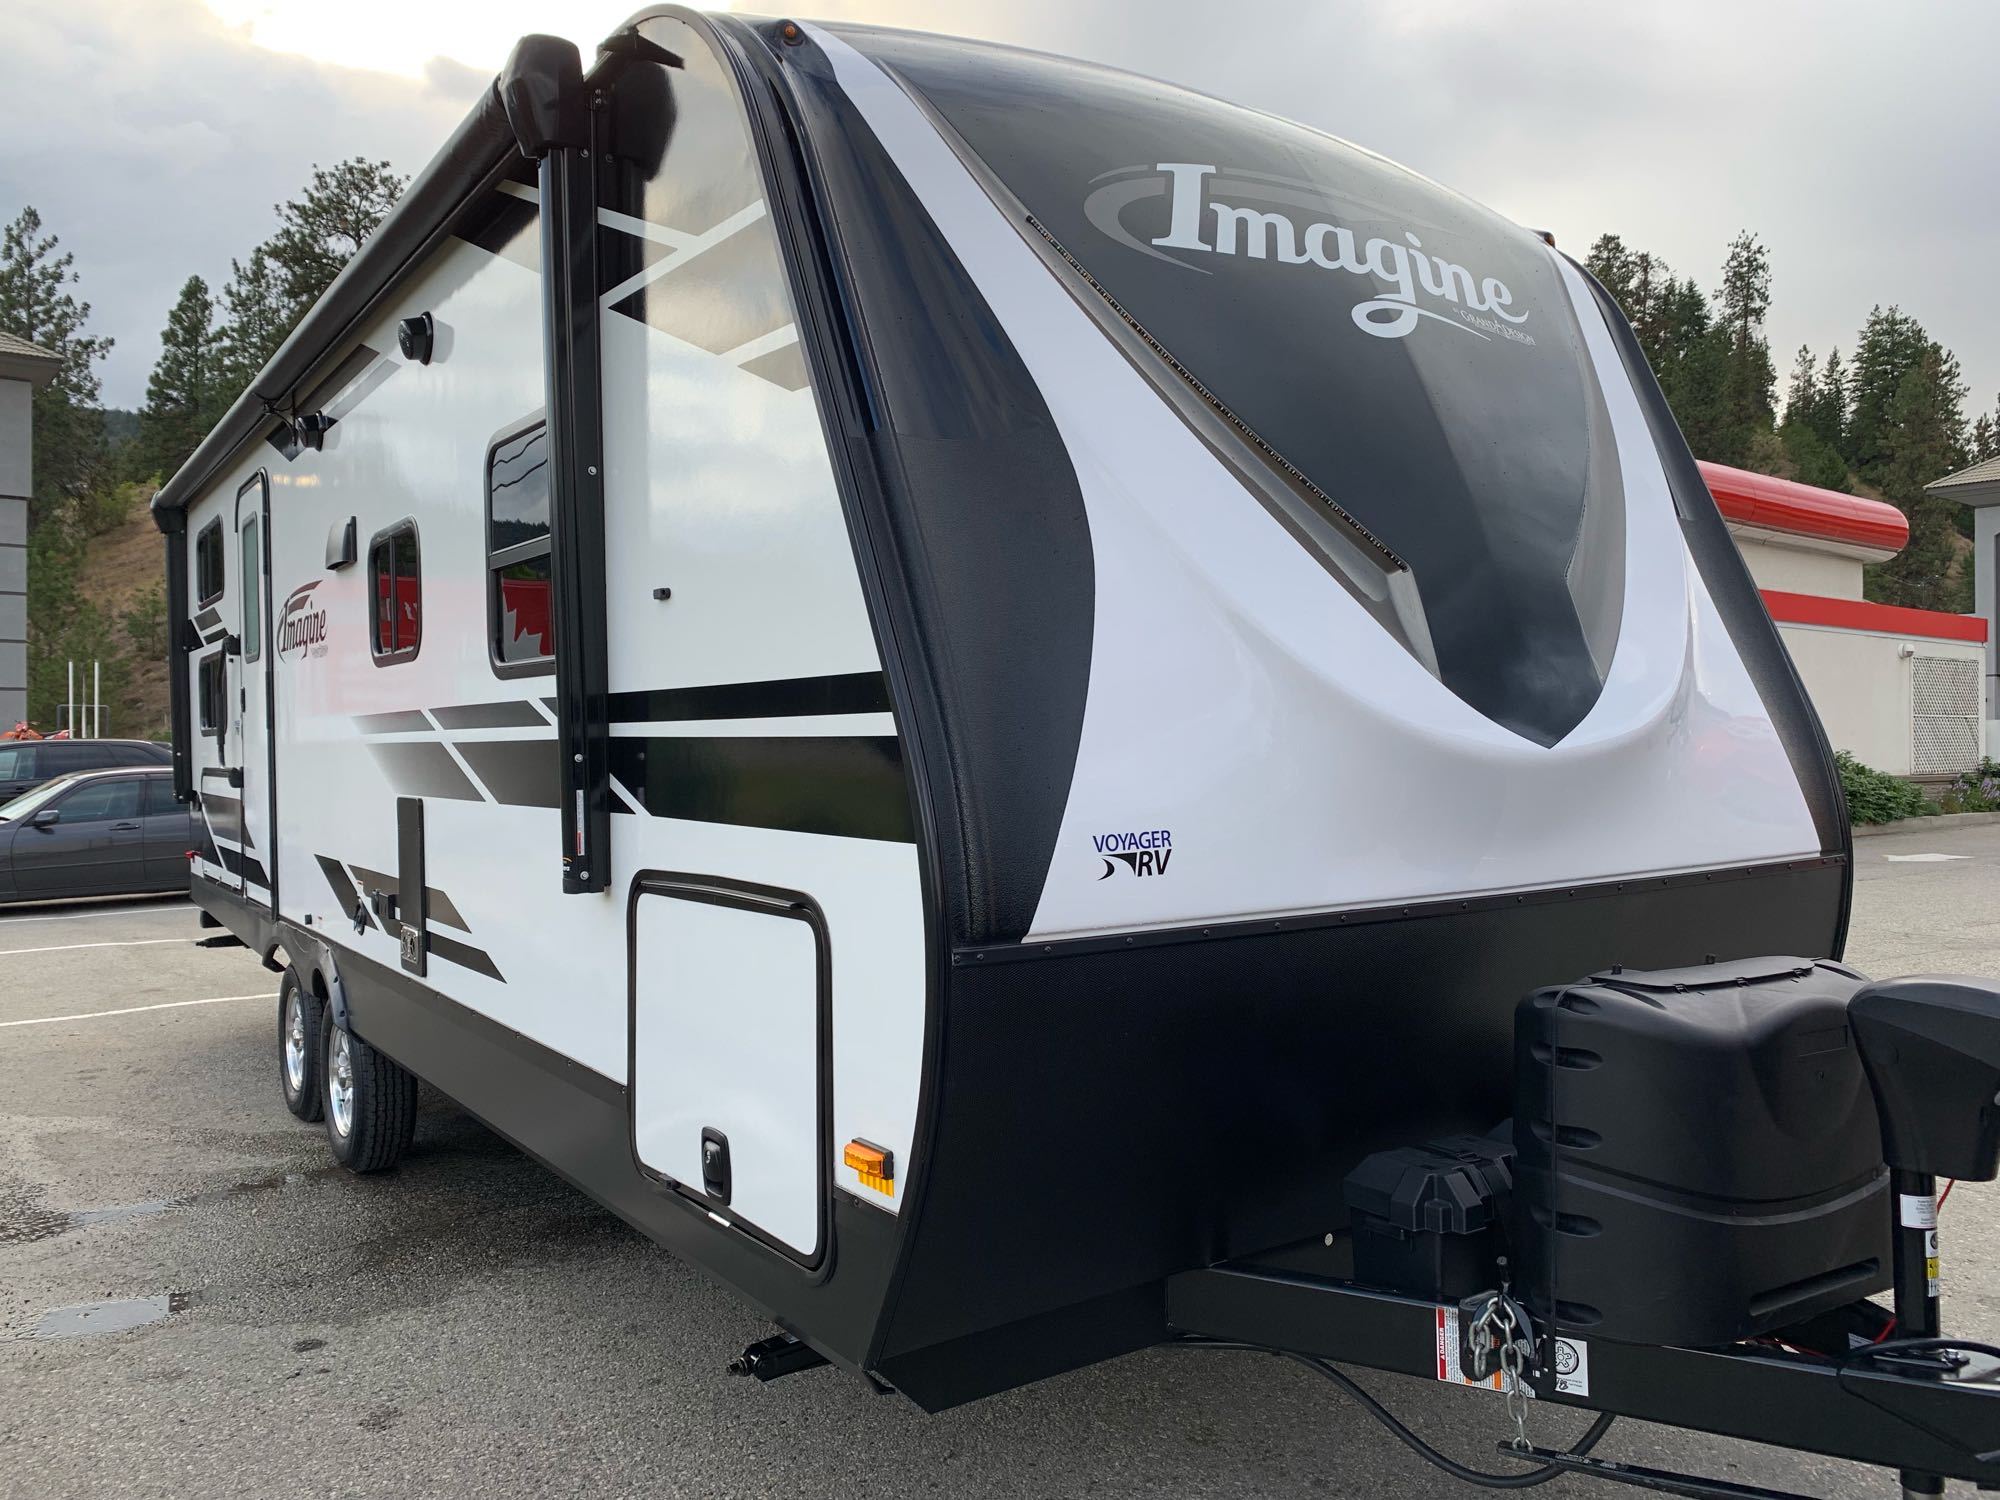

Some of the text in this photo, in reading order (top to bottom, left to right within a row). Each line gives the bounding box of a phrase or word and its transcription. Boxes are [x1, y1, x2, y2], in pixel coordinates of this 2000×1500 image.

[1151, 162, 1529, 340] Imagine
[281, 598, 328, 660] Imagine
[1092, 829, 1172, 853] VOYAGER
[1137, 848, 1172, 877] RV
